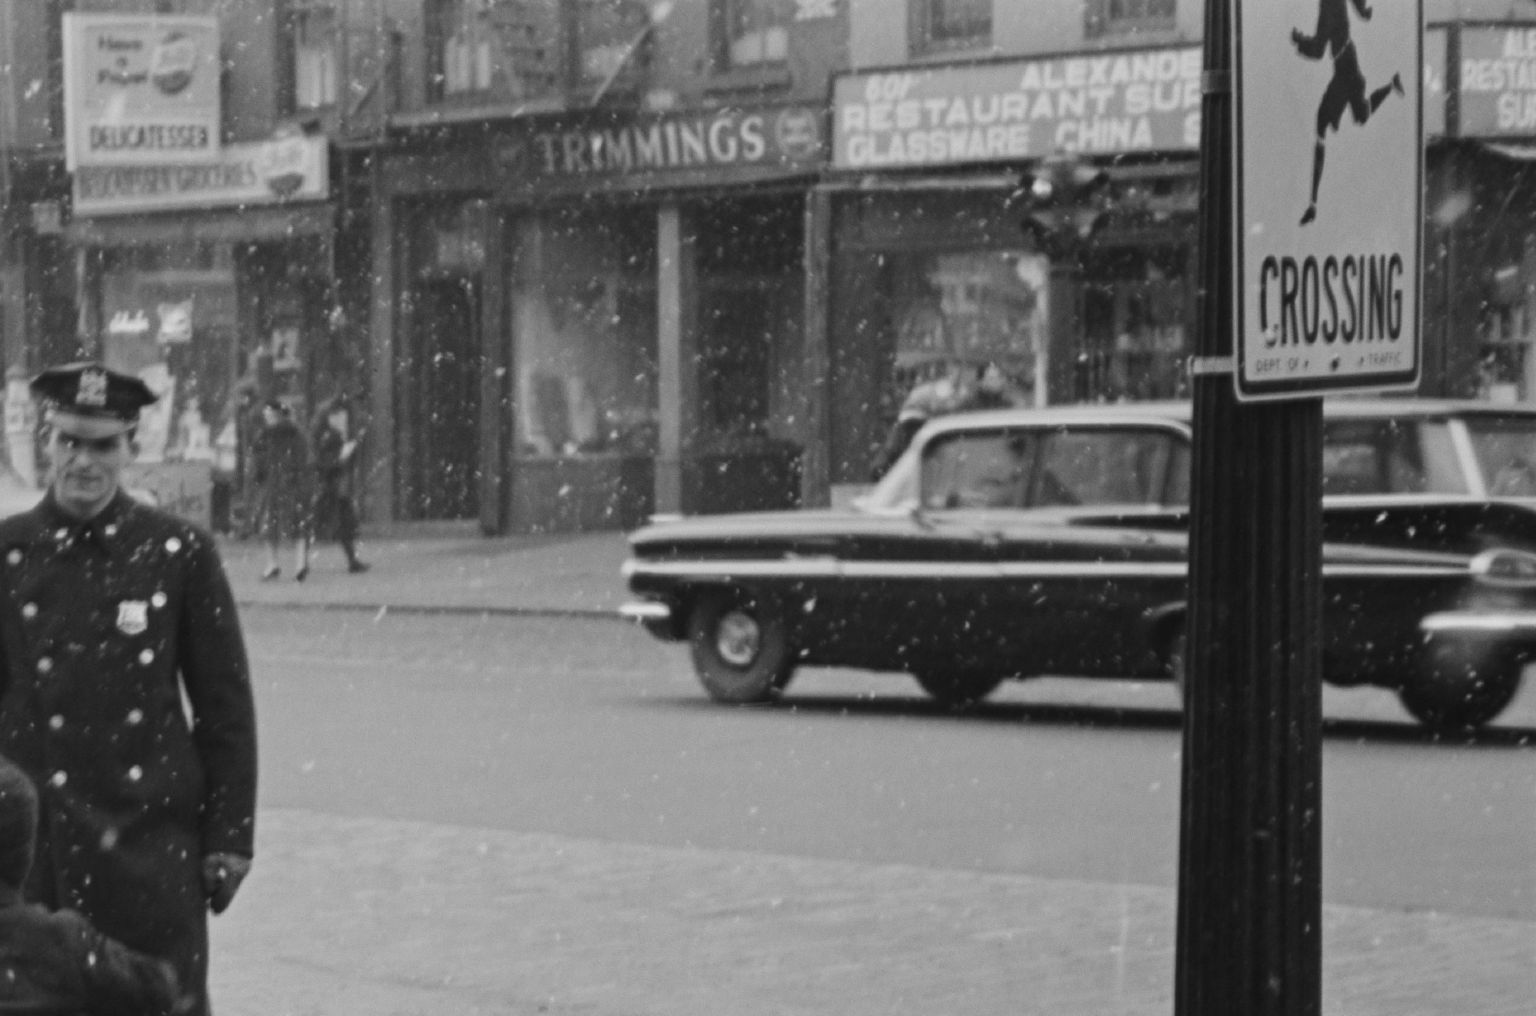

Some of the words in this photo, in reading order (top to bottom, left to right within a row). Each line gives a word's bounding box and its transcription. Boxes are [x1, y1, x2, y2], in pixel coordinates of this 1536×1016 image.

[842, 88, 1113, 132] RESTAURANT
[535, 115, 766, 175] TRIMMINGS
[848, 124, 1031, 165] GLASSWARE
[1055, 117, 1152, 153] CHINA
[1260, 252, 1403, 347] CROSSING
